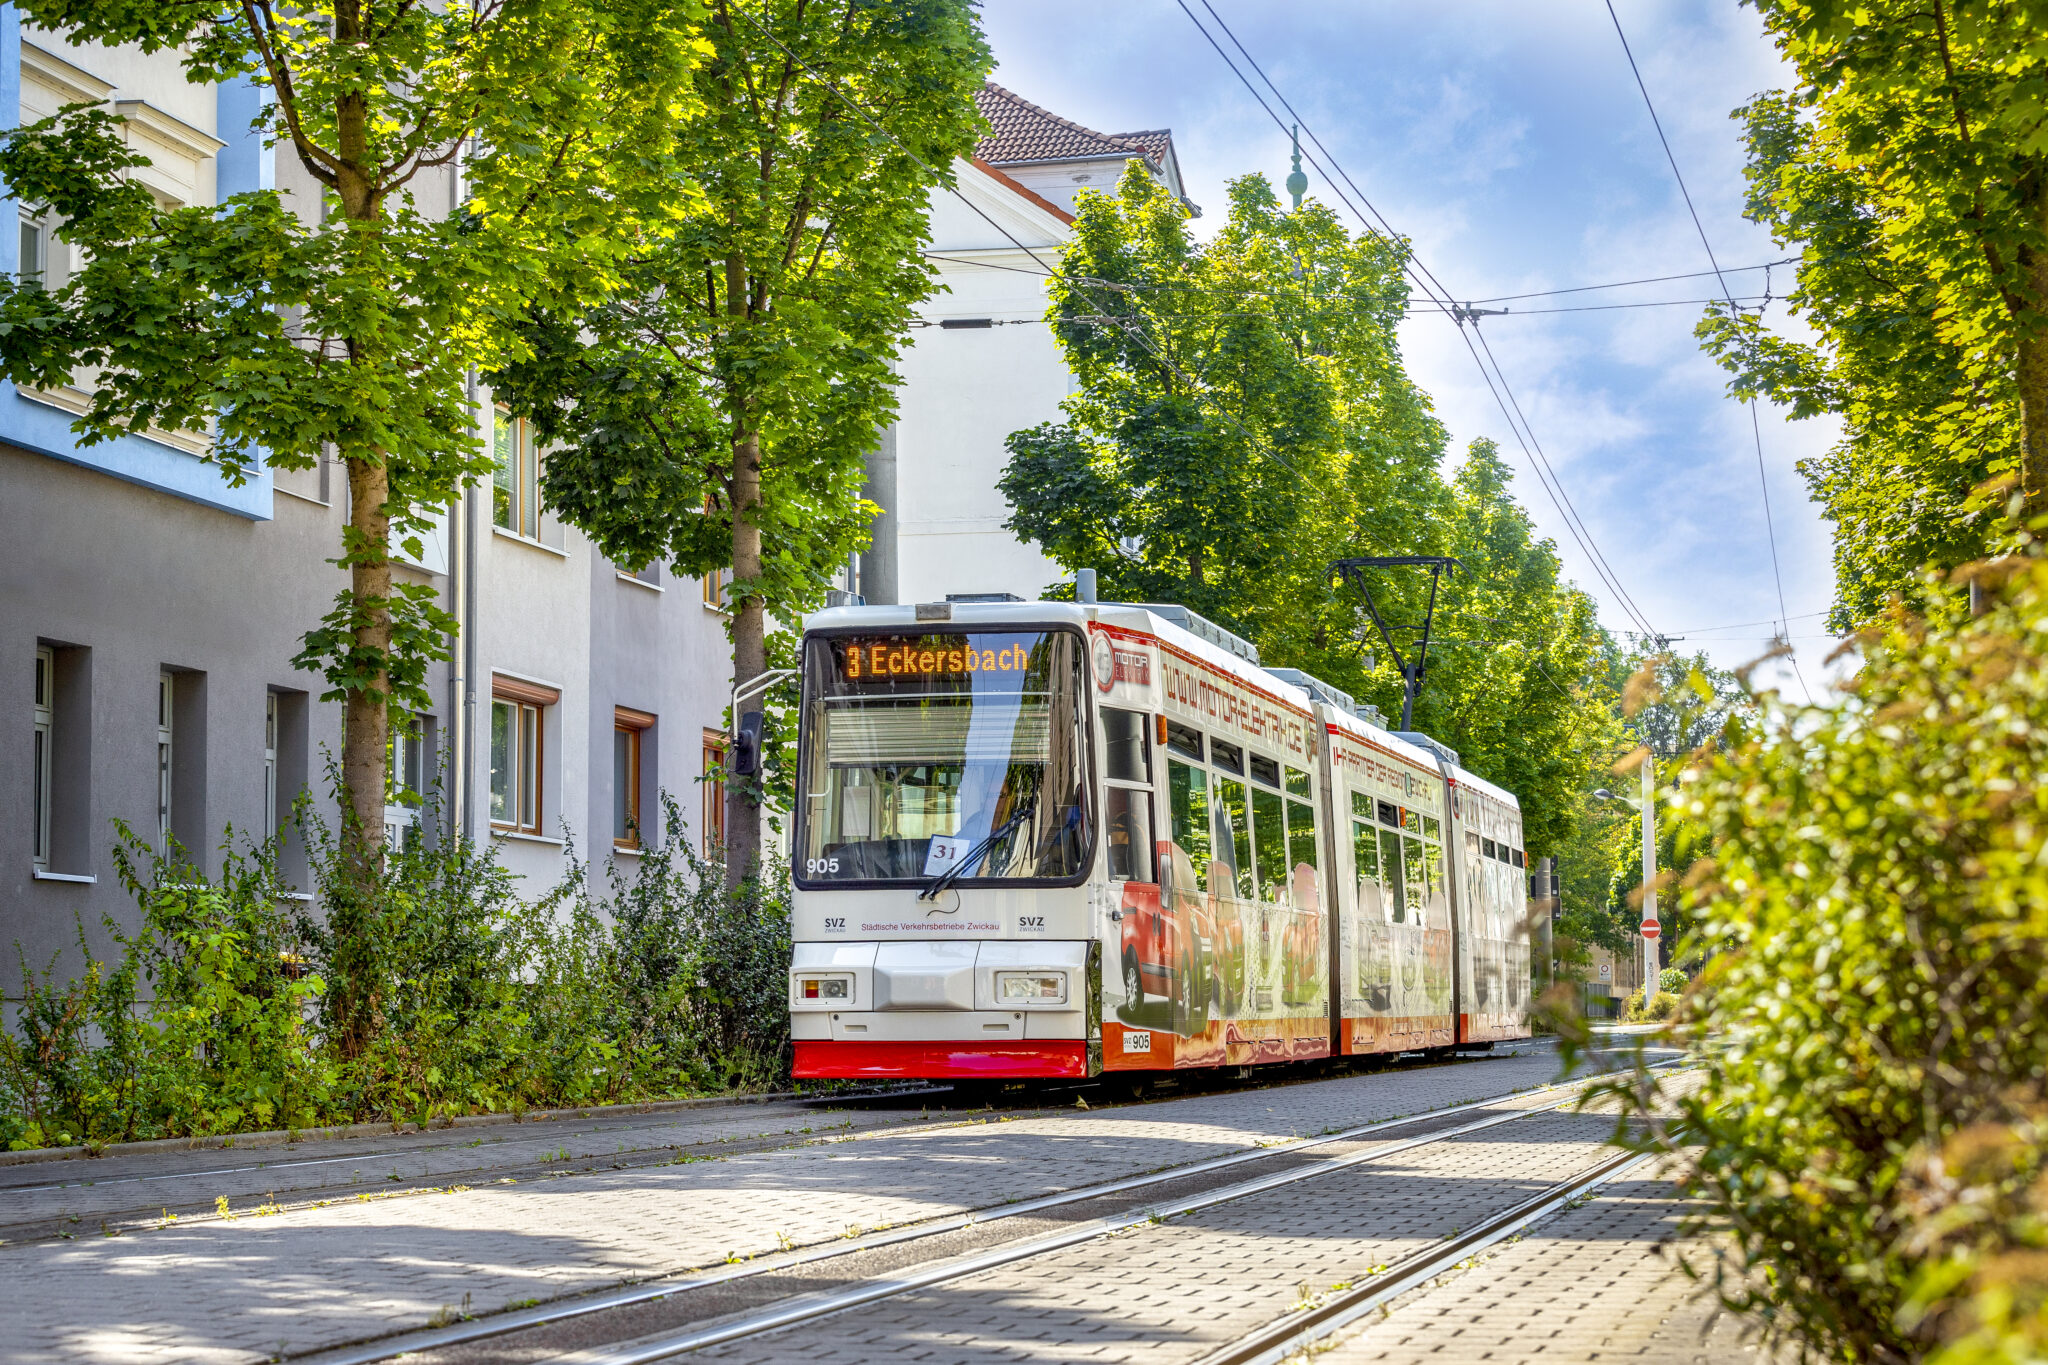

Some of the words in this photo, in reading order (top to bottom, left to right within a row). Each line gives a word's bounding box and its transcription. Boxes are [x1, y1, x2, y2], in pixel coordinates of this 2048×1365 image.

[848, 646, 860, 677] 3
[871, 643, 1028, 674] Eckersbach
[1114, 651, 1148, 668] MOTOR
[933, 844, 956, 860] 31
[806, 858, 840, 874] 905
[824, 918, 846, 928] SVZ
[861, 922, 899, 932] Städtische
[900, 922, 965, 931] Verkehrsbetriebe
[967, 922, 1000, 931] Zwickau
[1019, 916, 1045, 927] SVZ
[1132, 1035, 1150, 1049] 905
